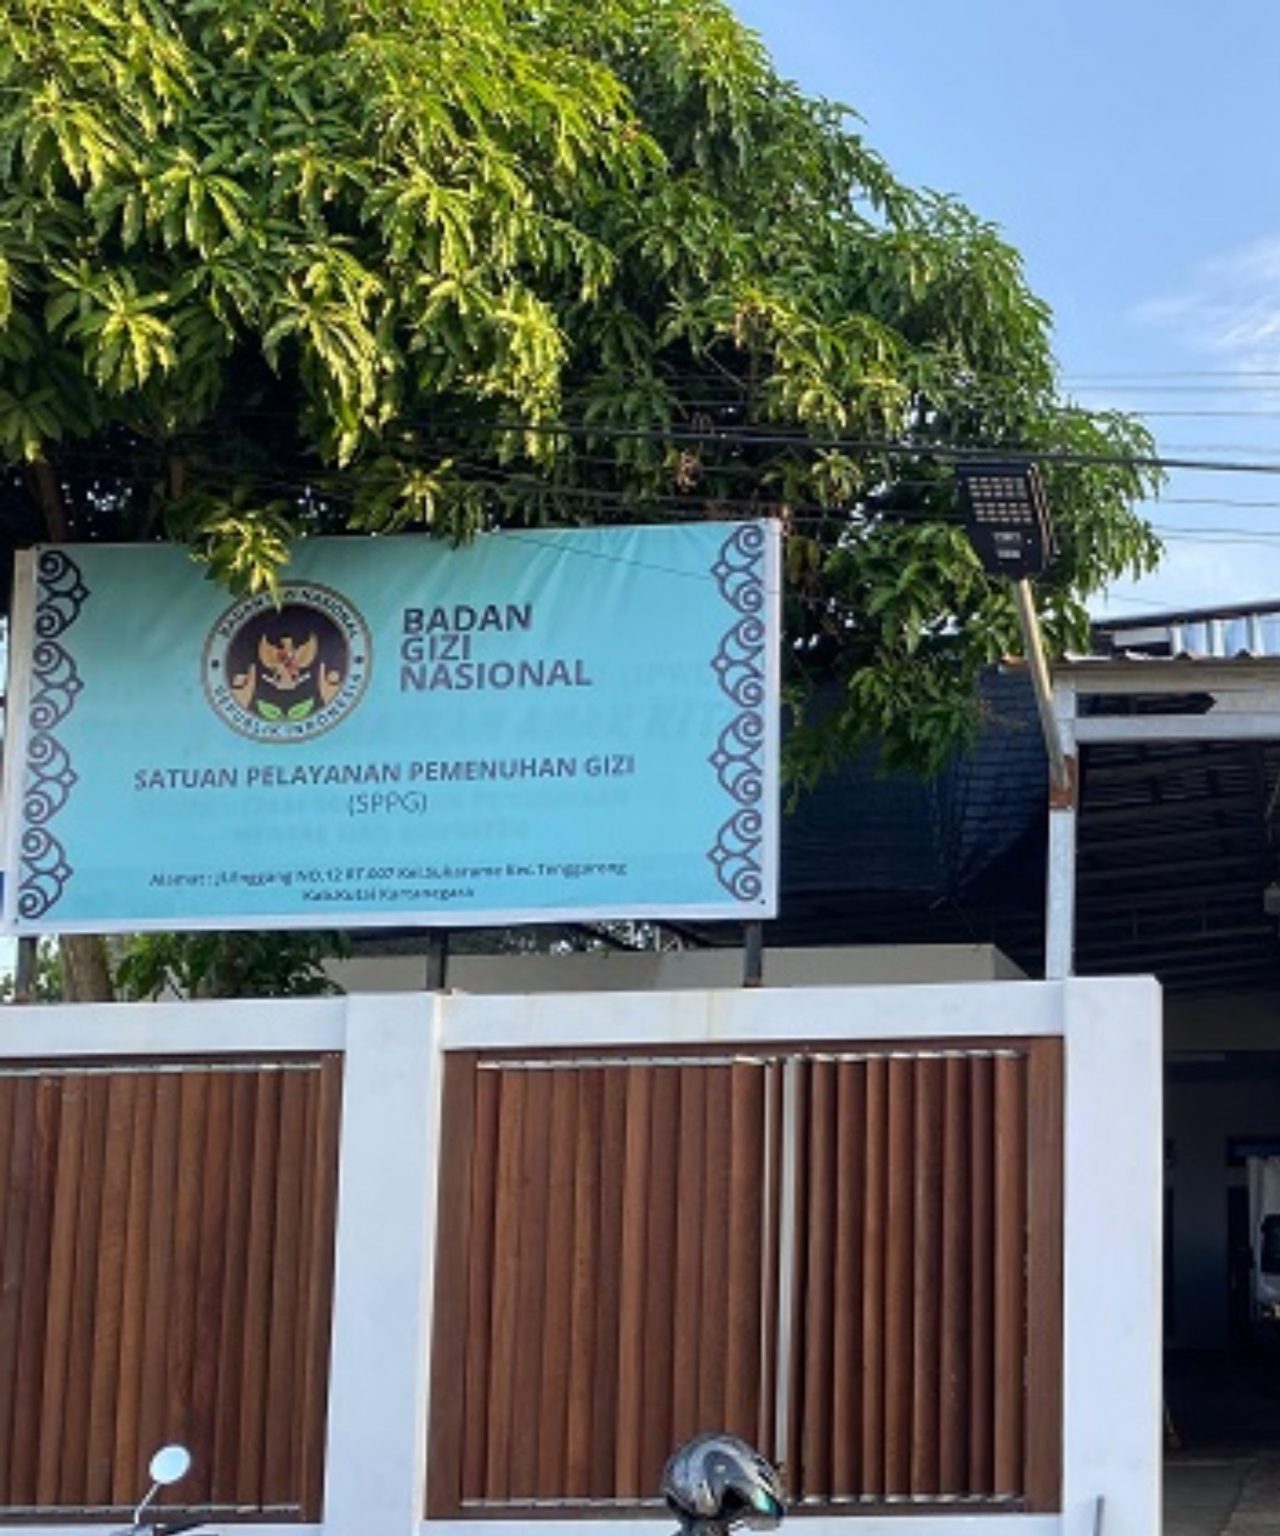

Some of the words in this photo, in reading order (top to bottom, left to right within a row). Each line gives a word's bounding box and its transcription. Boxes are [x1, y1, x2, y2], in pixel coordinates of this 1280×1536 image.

[403, 603, 532, 634] BADAN
[401, 634, 472, 662] GIZI
[400, 659, 593, 692] NASIONAL
[134, 768, 239, 791] SATUAN
[246, 761, 401, 788] PELAYANAN
[408, 757, 578, 783] PEMENUHAN
[585, 753, 636, 778] GIZI
[349, 790, 428, 818] (SPPG)
